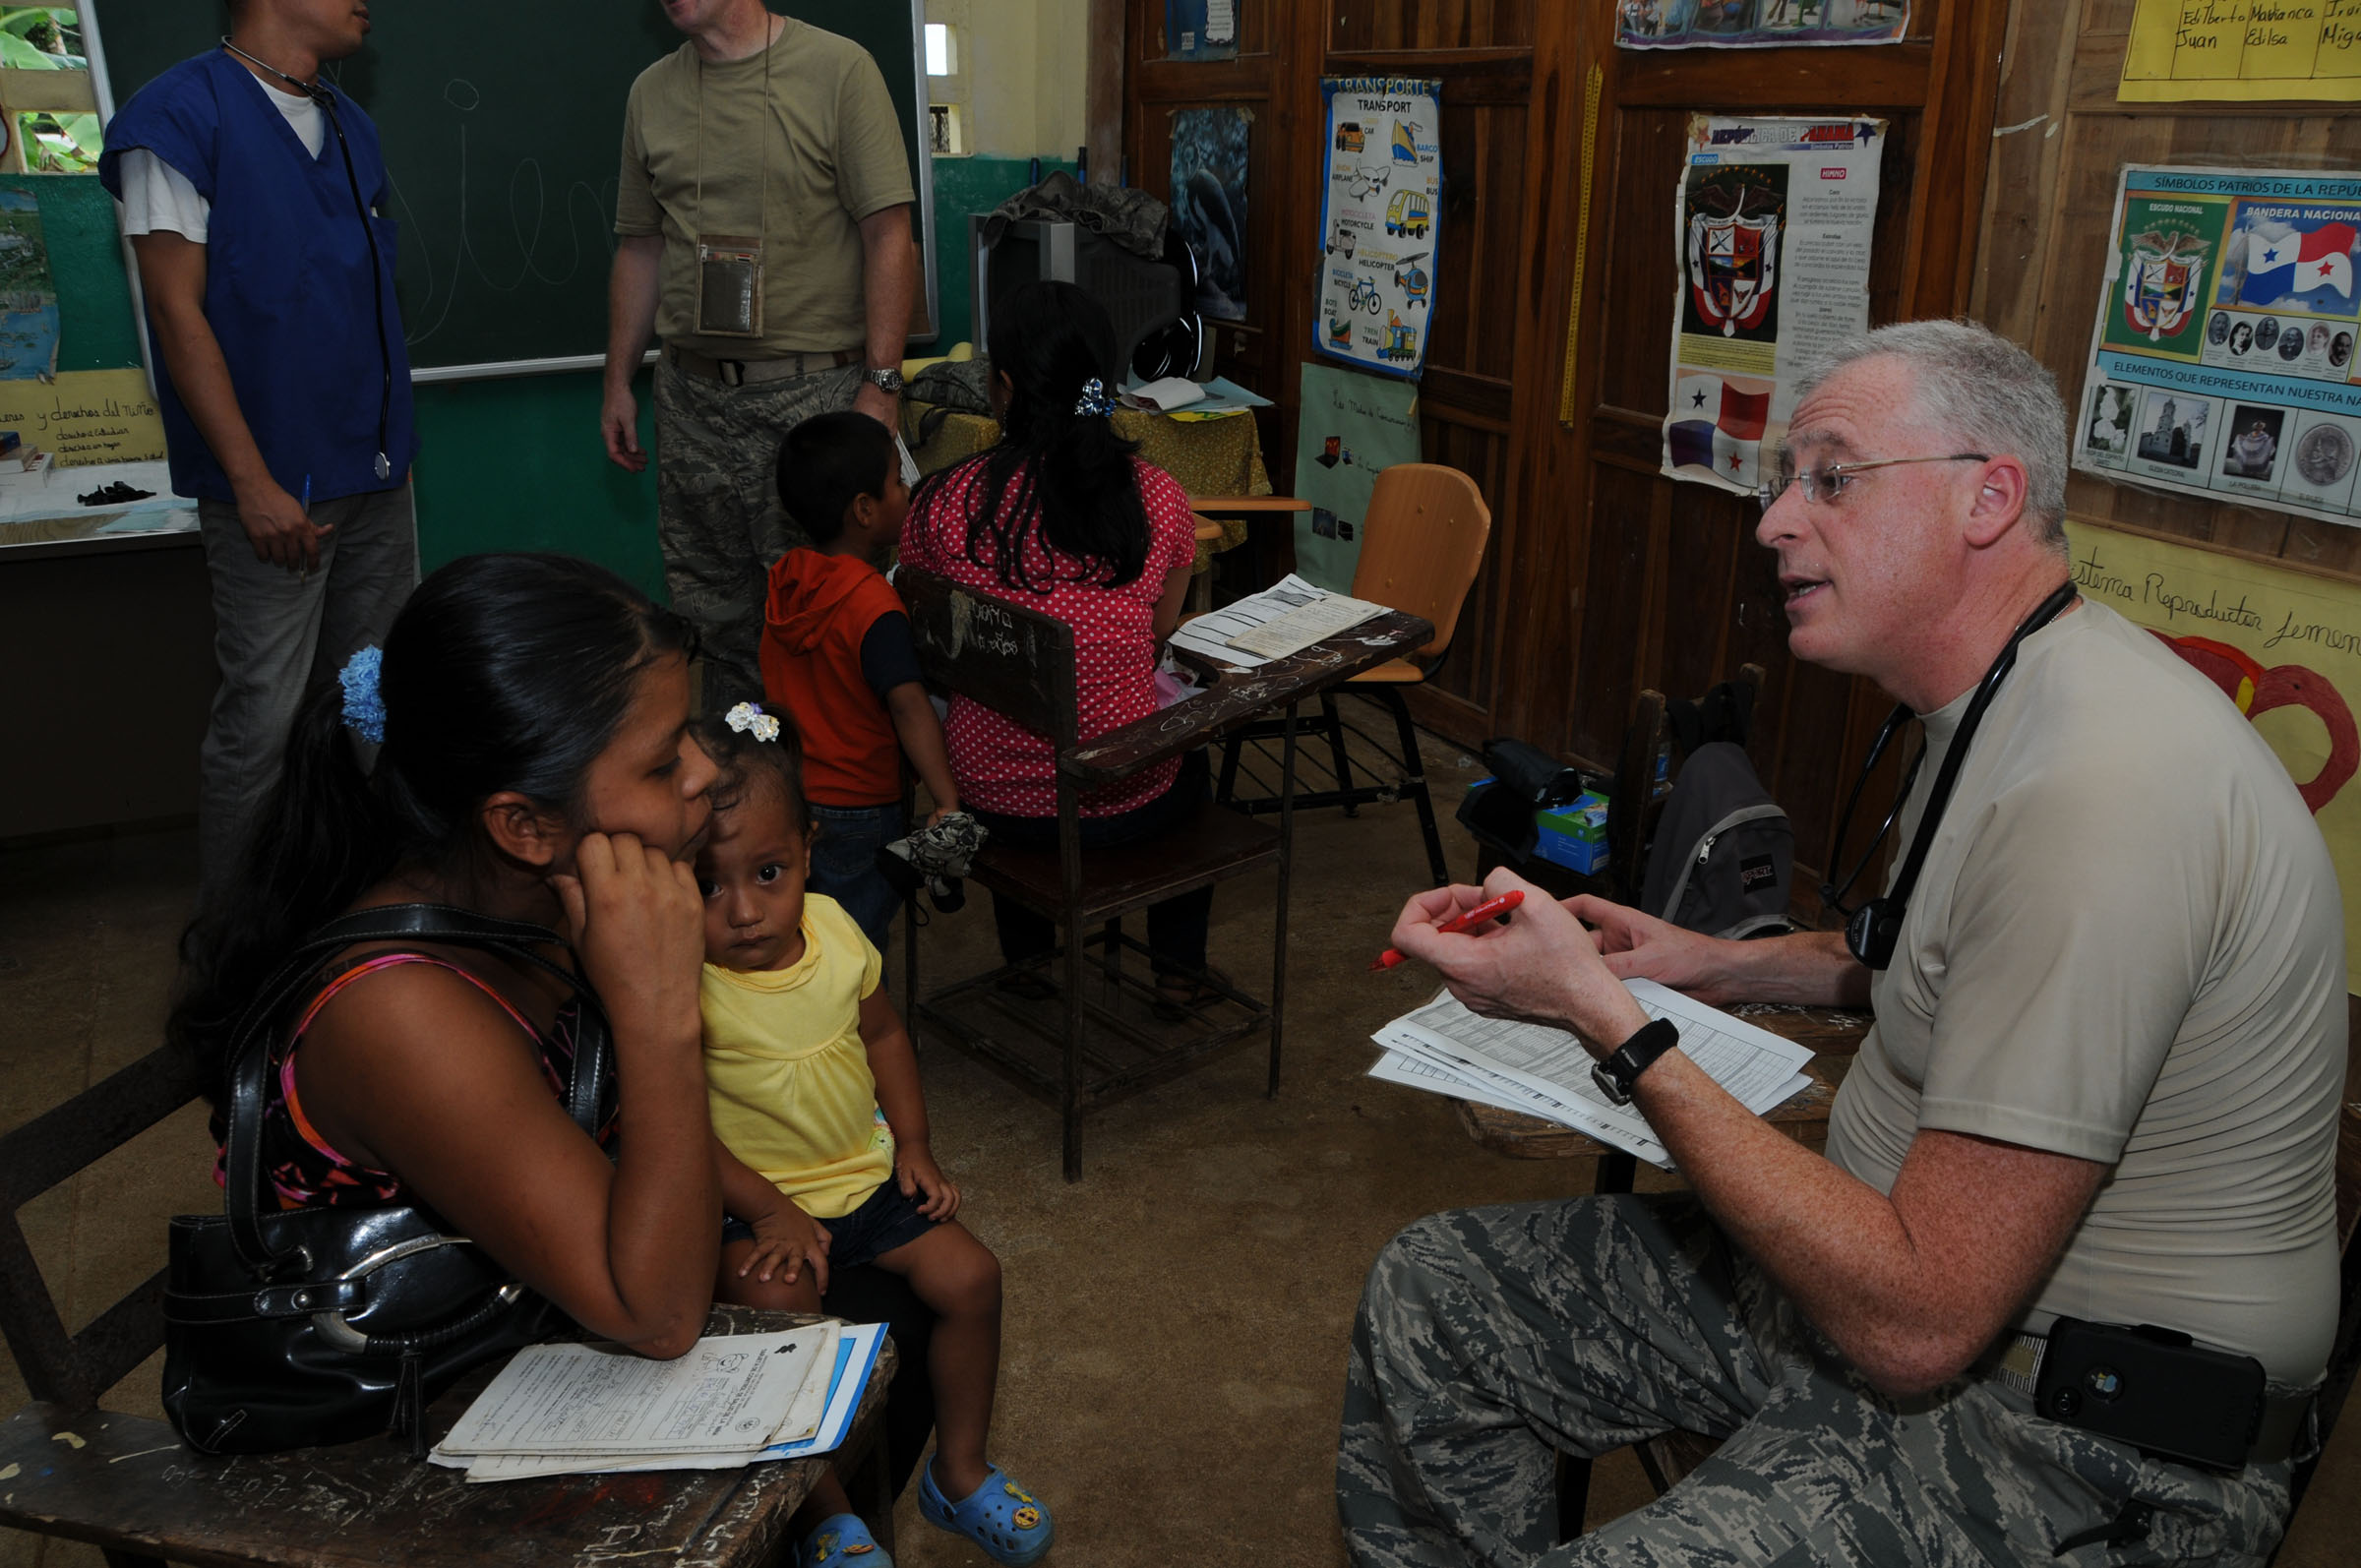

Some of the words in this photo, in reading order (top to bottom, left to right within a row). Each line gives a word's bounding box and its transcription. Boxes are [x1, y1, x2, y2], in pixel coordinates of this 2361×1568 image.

[2176, 29, 2217, 48] Juan
[2245, 28, 2288, 46] Edilsa
[1337, 78, 1430, 97] TRANSPORTE
[1358, 99, 1412, 113] TRANSPORT
[1780, 126, 1796, 143] DE
[1822, 169, 1846, 178] HIMNO
[2154, 175, 2213, 191] SÍMBOLOS
[2217, 181, 2269, 194] PATRIOS
[2272, 183, 2291, 195] DE
[2295, 184, 2313, 195] LA
[2149, 203, 2173, 212] ESCUDO
[2174, 204, 2204, 214] NACIONAL
[2246, 207, 2299, 218] BANDERA
[1341, 219, 1375, 230] MOTORCYCLE
[1359, 259, 1396, 271] HELICOPTER
[1362, 335, 1378, 346] TRAIN
[2114, 361, 2173, 380] ELEMENTOS
[2175, 372, 2197, 384] QUE
[2200, 374, 2285, 395] REPRESENTAN
[2288, 386, 2343, 403] NUESTRA
[102, 397, 120, 418] del
[2070, 546, 2135, 601] istema
